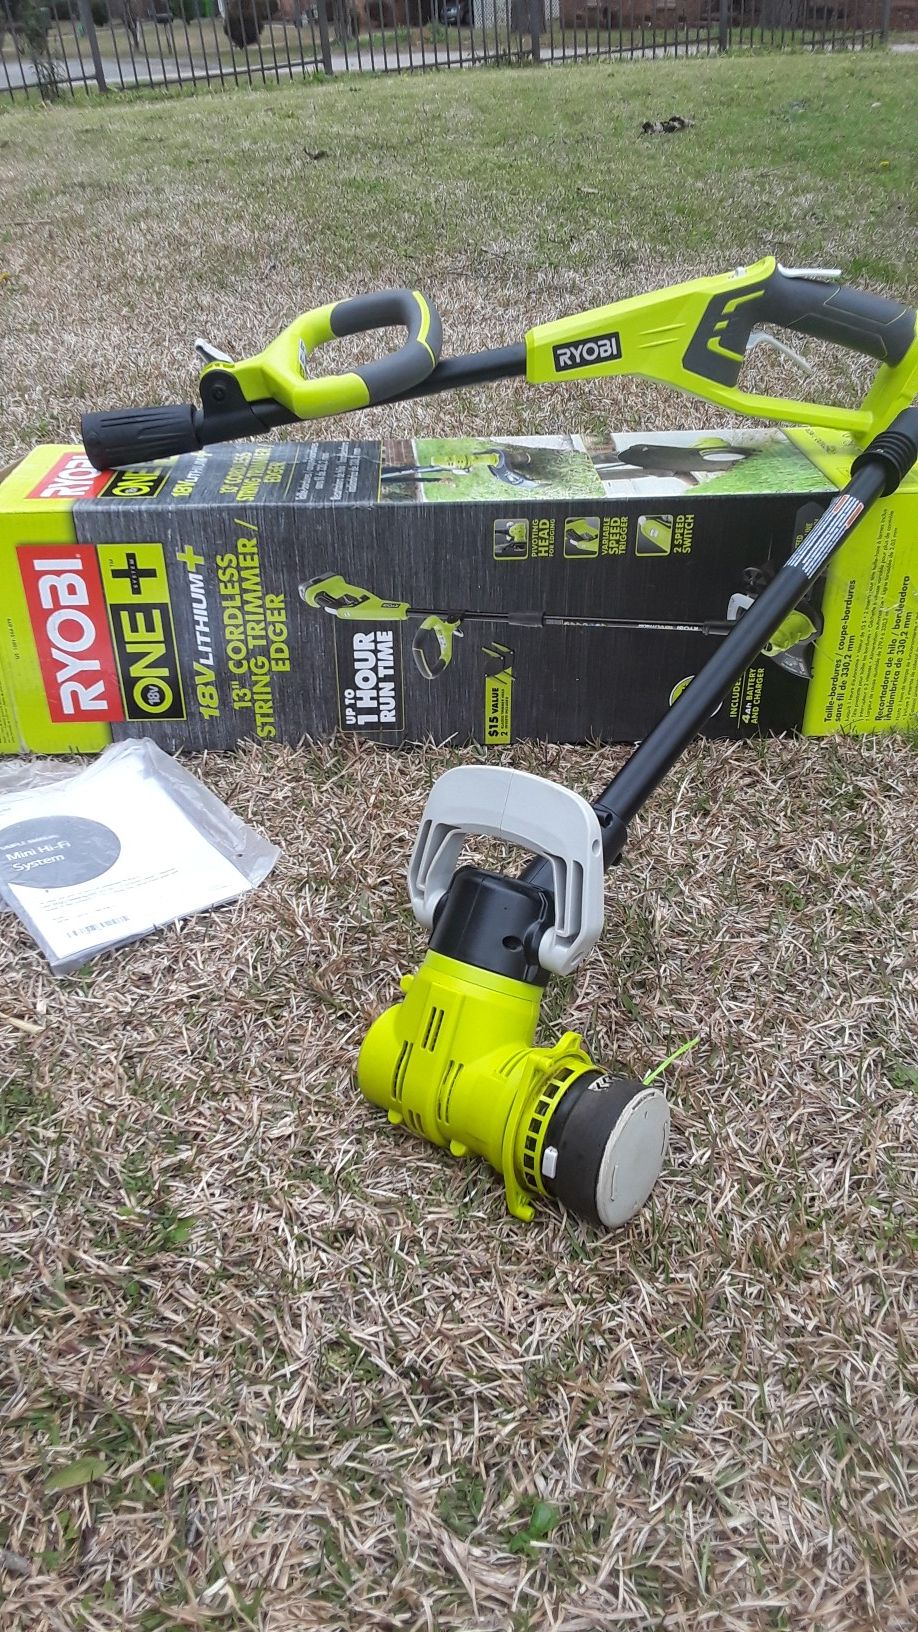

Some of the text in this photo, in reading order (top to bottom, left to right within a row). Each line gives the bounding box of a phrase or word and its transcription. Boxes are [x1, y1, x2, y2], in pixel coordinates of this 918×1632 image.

[557, 337, 617, 367] RYOBI
[531, 518, 539, 557] PIVOTING
[538, 518, 550, 557] HEAD
[601, 516, 610, 556] VARIABLE
[608, 517, 621, 555] SPEED
[618, 515, 628, 555] TRIGGER
[674, 514, 684, 545] SPEED
[682, 513, 694, 554] SWITCH
[130, 558, 139, 590] SYSTEM
[236, 537, 269, 650] TRIMMER
[216, 553, 250, 675] CORDLESS
[892, 575, 910, 630] bordeadora
[903, 611, 913, 629] mm
[33, 558, 109, 714] RYOBI
[265, 593, 291, 673] EDGER
[824, 657, 842, 723] Taille-bordures
[838, 579, 857, 651] coupe-bordures
[847, 634, 856, 652] mm
[887, 638, 897, 655] hilo
[896, 631, 909, 655] 330,2
[376, 630, 395, 678] TIME
[841, 653, 853, 679] 330,2
[885, 657, 893, 667] de
[895, 657, 903, 668] de
[250, 655, 277, 738] STRING
[353, 631, 379, 725] 1 HOUR
[745, 668, 757, 700] BATTERY
[751, 668, 765, 724] AND CHARGER
[839, 680, 848, 691] de
[875, 670, 891, 720] Recortadora
[883, 670, 900, 720] inalámbrica
[344, 688, 356, 725] UP TO
[378, 682, 396, 723] RUN
[488, 687, 500, 737] $15 VALUE
[835, 703, 844, 722] sans
[5, 848, 37, 861] Mini
[37, 840, 72, 854] Hi-Fi
[12, 854, 65, 872] System
